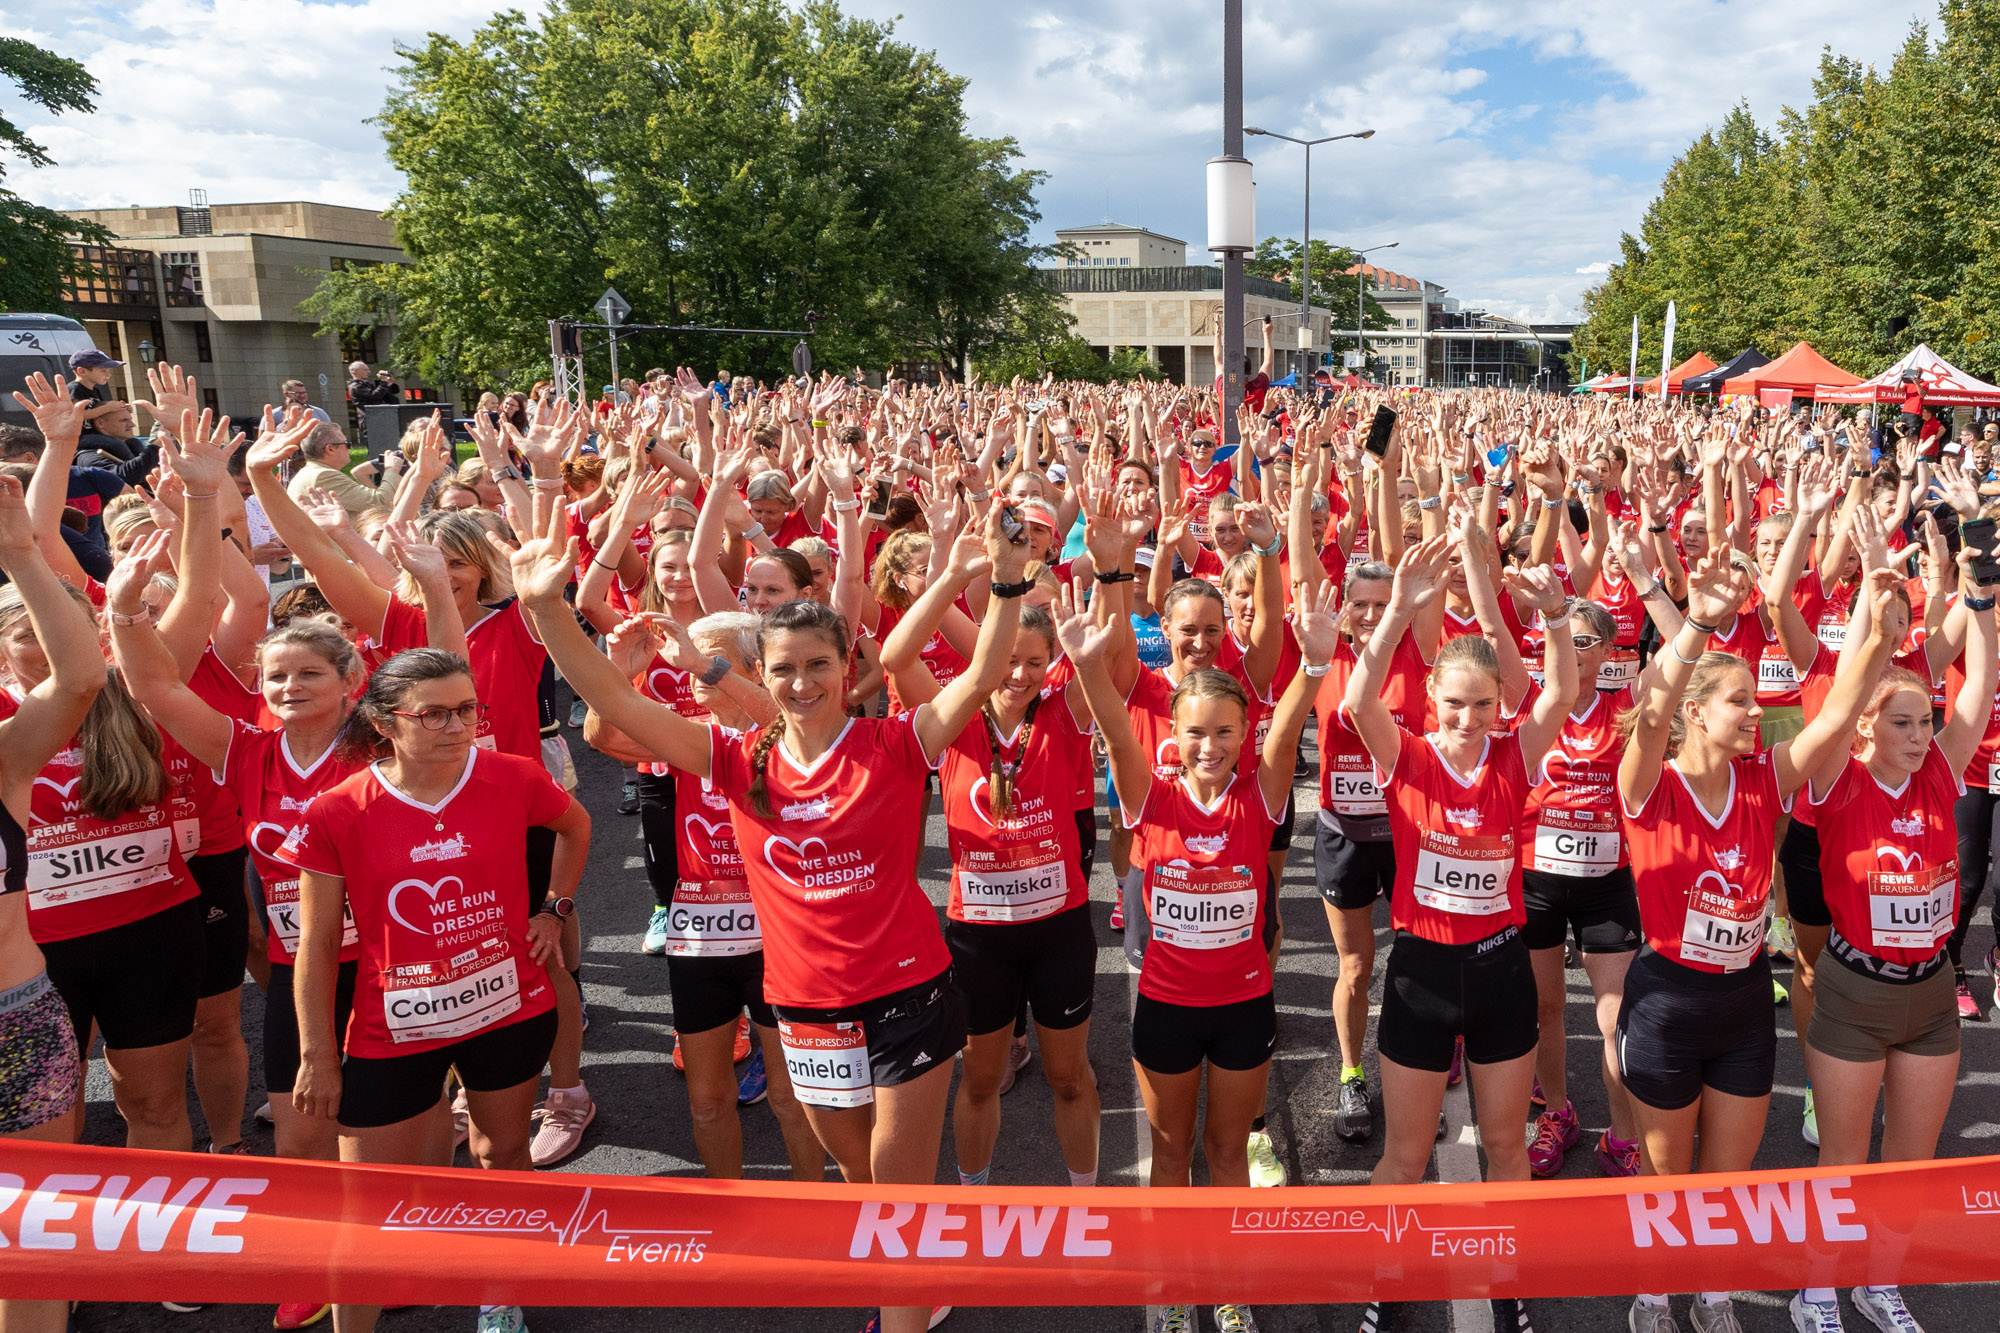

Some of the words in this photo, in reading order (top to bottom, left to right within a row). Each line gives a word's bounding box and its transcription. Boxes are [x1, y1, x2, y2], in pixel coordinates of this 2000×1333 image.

[1566, 771, 1584, 780] WE
[1587, 772, 1610, 782] RUN
[1335, 777, 1385, 799] Eve
[1565, 784, 1614, 794] DRESDEN
[1021, 796, 1044, 813] RUN
[1564, 796, 1611, 804] #WEUNITED
[997, 810, 1053, 830] DRESDEN
[1545, 818, 1587, 829] FRAUENLAUF
[1546, 809, 1570, 819] REWE
[33, 822, 77, 839] REWE
[34, 827, 110, 849] FRAUENLAUF
[113, 819, 160, 834] DRESDEN
[999, 825, 1054, 842] #WEUNITED
[1430, 830, 1459, 846] REWE
[710, 839, 729, 850] WE
[1428, 841, 1480, 858] FRAUENLAUF
[1481, 848, 1511, 859] DRESDEN
[1555, 834, 1598, 856] Grit
[28, 852, 55, 861] 10284
[50, 844, 146, 880] Silke
[798, 859, 824, 871] WE
[827, 849, 862, 867] RUN
[968, 861, 1017, 871] FRAUENLAUF
[1019, 853, 1056, 867] DRESDEN
[970, 851, 995, 861] REWE
[804, 863, 875, 888] DRESDEN
[1162, 868, 1188, 880] REWE
[1434, 861, 1497, 891] Lene
[1880, 874, 1914, 884] REWE
[681, 882, 701, 892] REWE
[804, 879, 876, 902] #WEUNITED
[968, 876, 1052, 896] Franziska
[1160, 877, 1210, 892] FRAUENLAUF
[1211, 879, 1249, 892] DRESDEN
[429, 899, 457, 917] WE
[462, 890, 496, 909] RUN
[679, 892, 721, 902] FRAUENLAUF
[1702, 891, 1735, 910] REWE
[1156, 895, 1245, 923] Pauline
[1700, 901, 1756, 920] FRAUENLAUF
[1890, 897, 1941, 925] Luia
[432, 905, 505, 935] DRESDEN
[672, 908, 756, 932] Gerda
[1180, 923, 1199, 931] 10503
[1477, 934, 1505, 954] NIKE
[1505, 926, 1519, 941] PR
[396, 964, 432, 977] REWE
[453, 951, 476, 966] 10148
[396, 970, 459, 987] FRAUENLAUF
[461, 950, 505, 975] DRESDEN
[391, 975, 505, 1018] Cornelia
[815, 1036, 857, 1047] DRESDEN
[786, 1057, 853, 1080] aniela
[385, 1200, 547, 1227] Laufszene
[1231, 1207, 1365, 1228] Laufszene
[1626, 1176, 1867, 1248] REWE
[849, 1201, 1112, 1258] REWE
[606, 1236, 707, 1263] Events
[1431, 1232, 1516, 1256] Events
